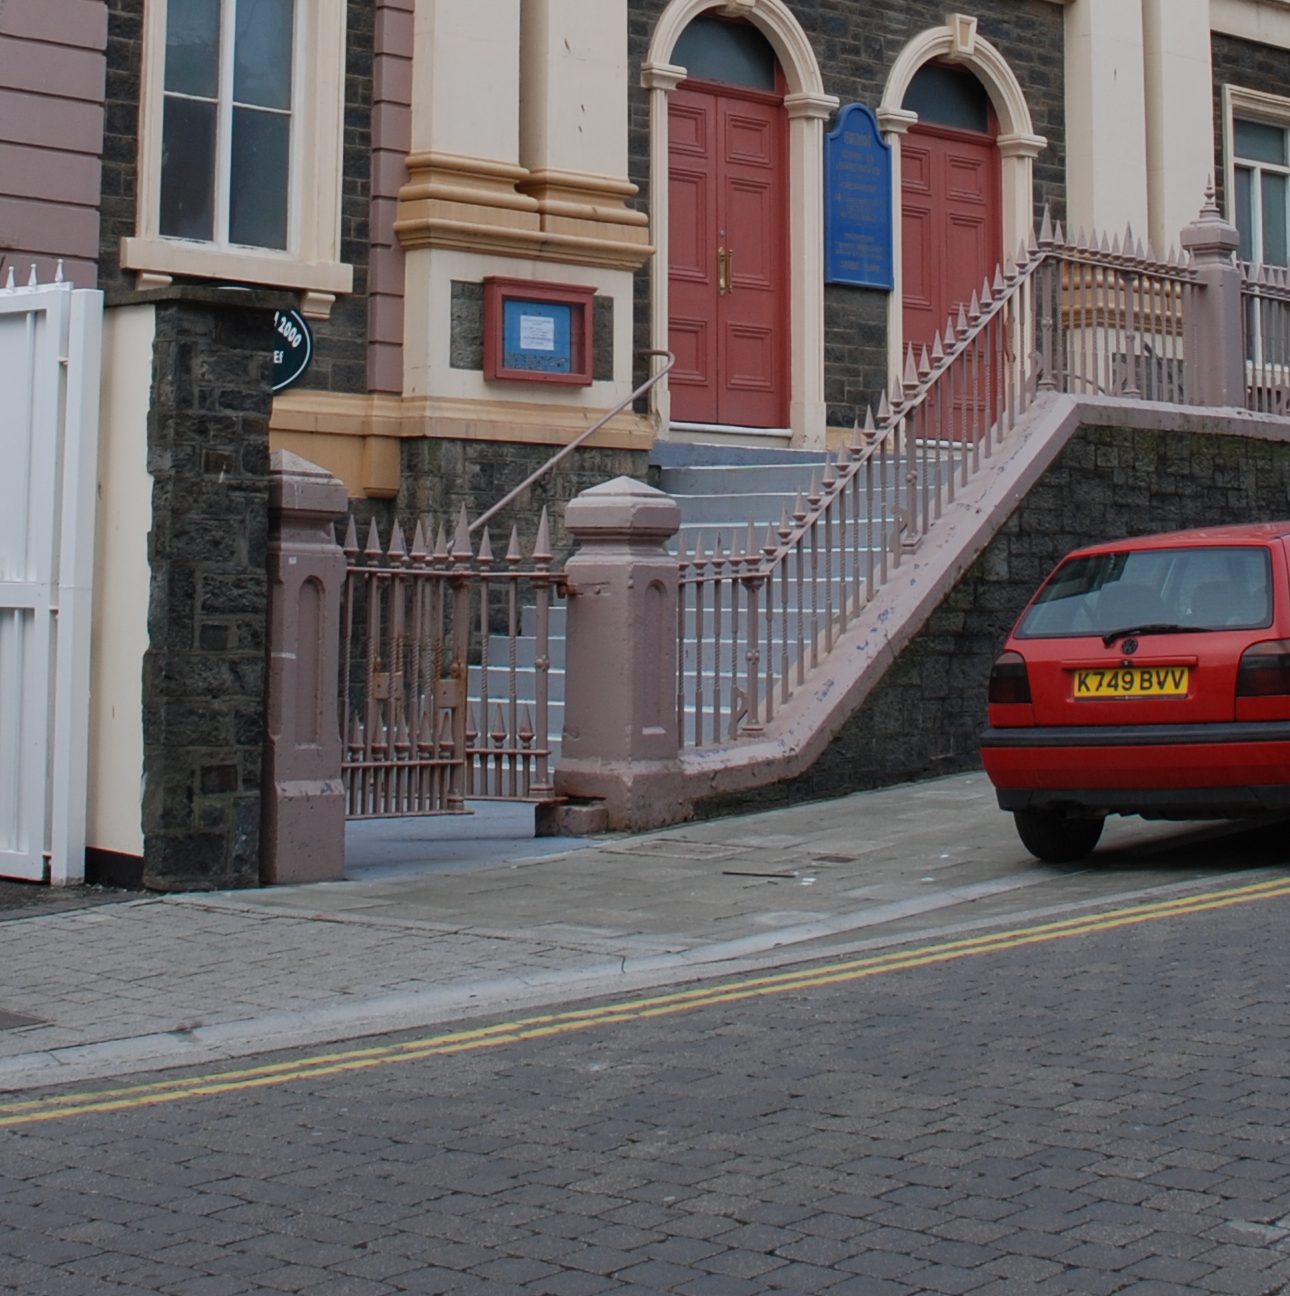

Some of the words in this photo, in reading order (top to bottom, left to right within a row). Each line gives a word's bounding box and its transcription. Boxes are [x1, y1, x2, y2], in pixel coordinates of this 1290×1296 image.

[277, 316, 302, 348] 2000
[1077, 670, 1135, 692] K749
[1139, 669, 1185, 691] BVV
